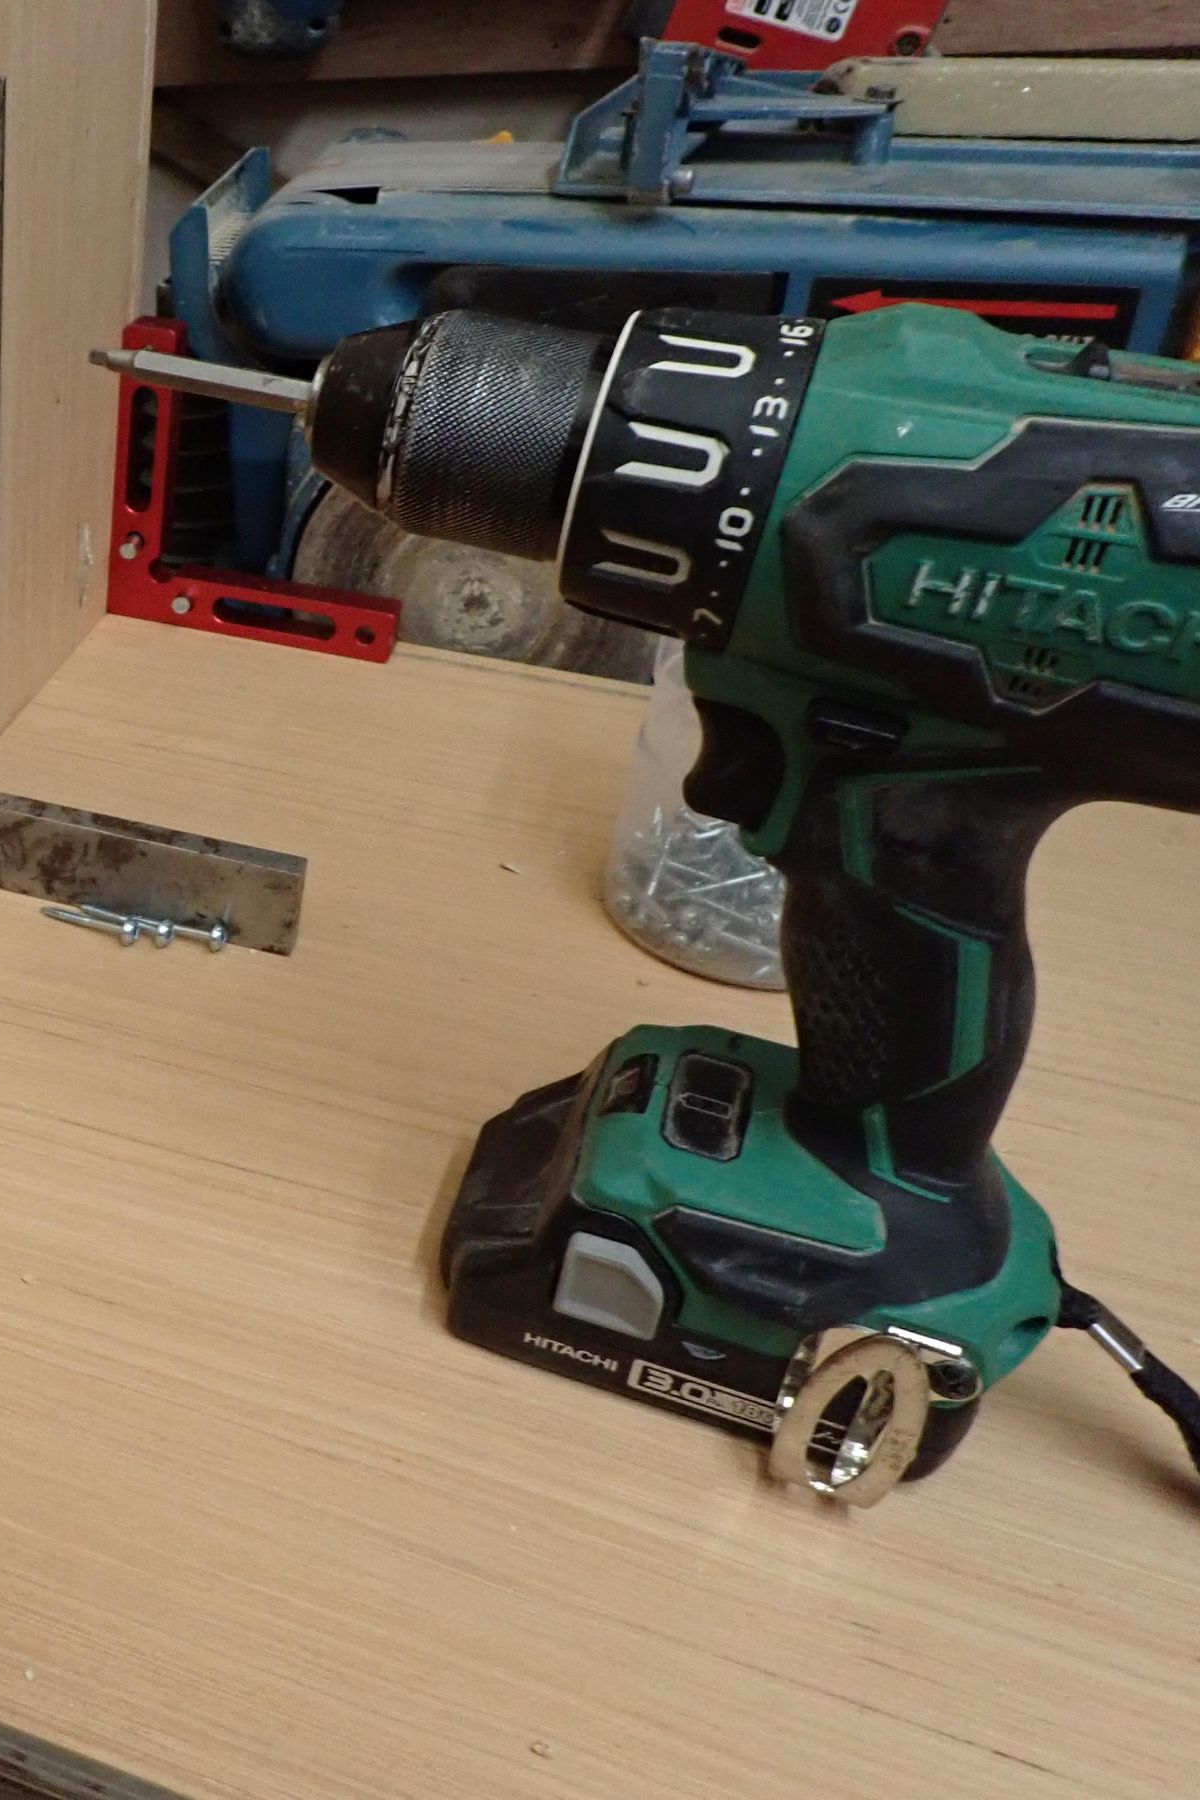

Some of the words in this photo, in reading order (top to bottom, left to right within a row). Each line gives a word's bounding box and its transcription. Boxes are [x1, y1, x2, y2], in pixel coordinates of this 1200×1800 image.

[715, 506, 754, 552] 10
[749, 395, 789, 437] 13
[779, 323, 814, 346] 16
[523, 1332, 619, 1372] HITACHI
[642, 1366, 711, 1404] 3.0
